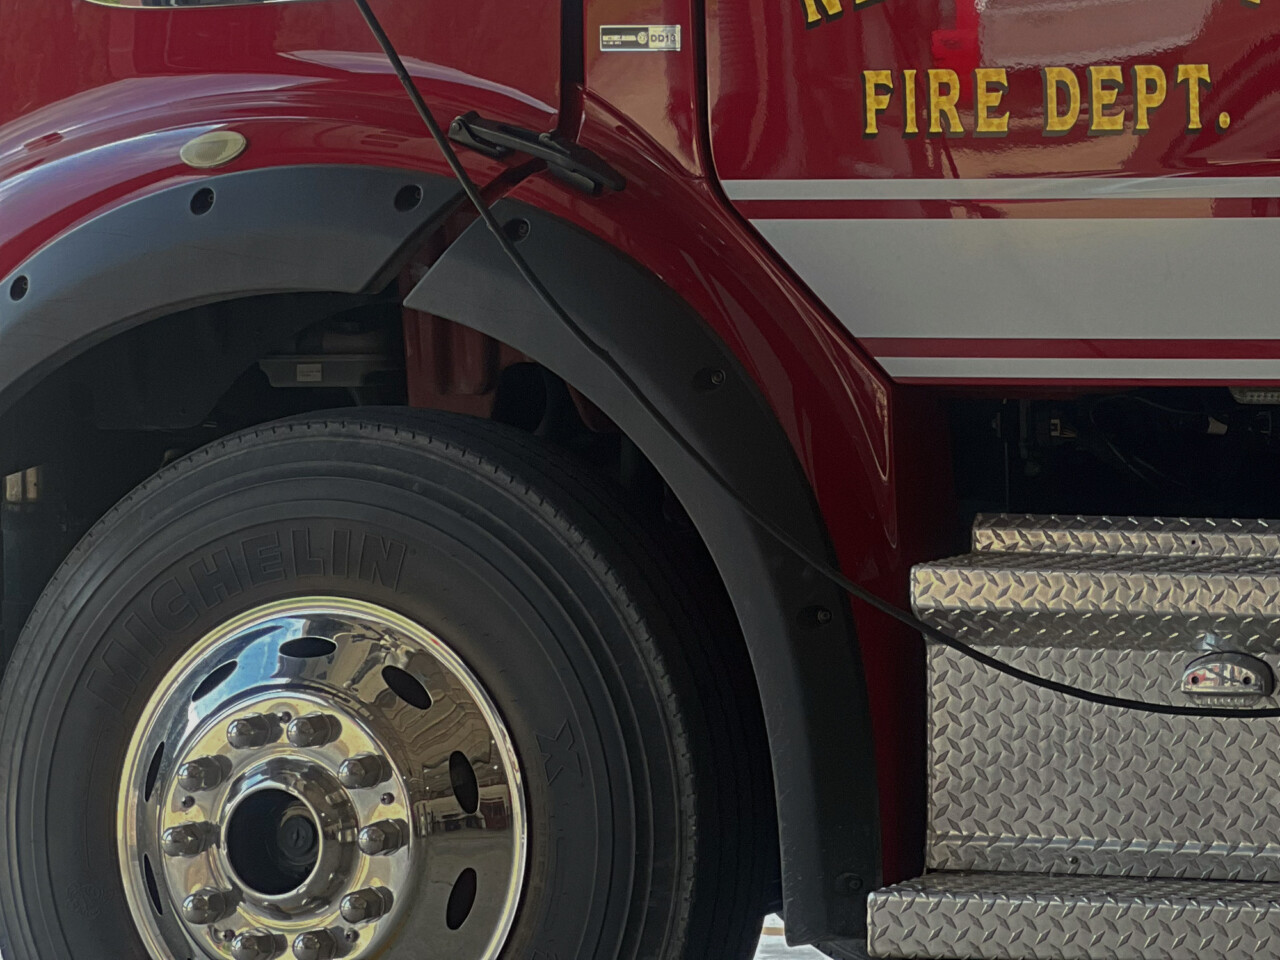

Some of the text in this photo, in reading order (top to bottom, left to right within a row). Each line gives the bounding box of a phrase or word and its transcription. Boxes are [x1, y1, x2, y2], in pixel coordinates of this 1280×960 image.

[650, 34, 676, 42] DD13
[863, 63, 1231, 137] FIRE DEPT.
[85, 527, 407, 712] MICHELIN
